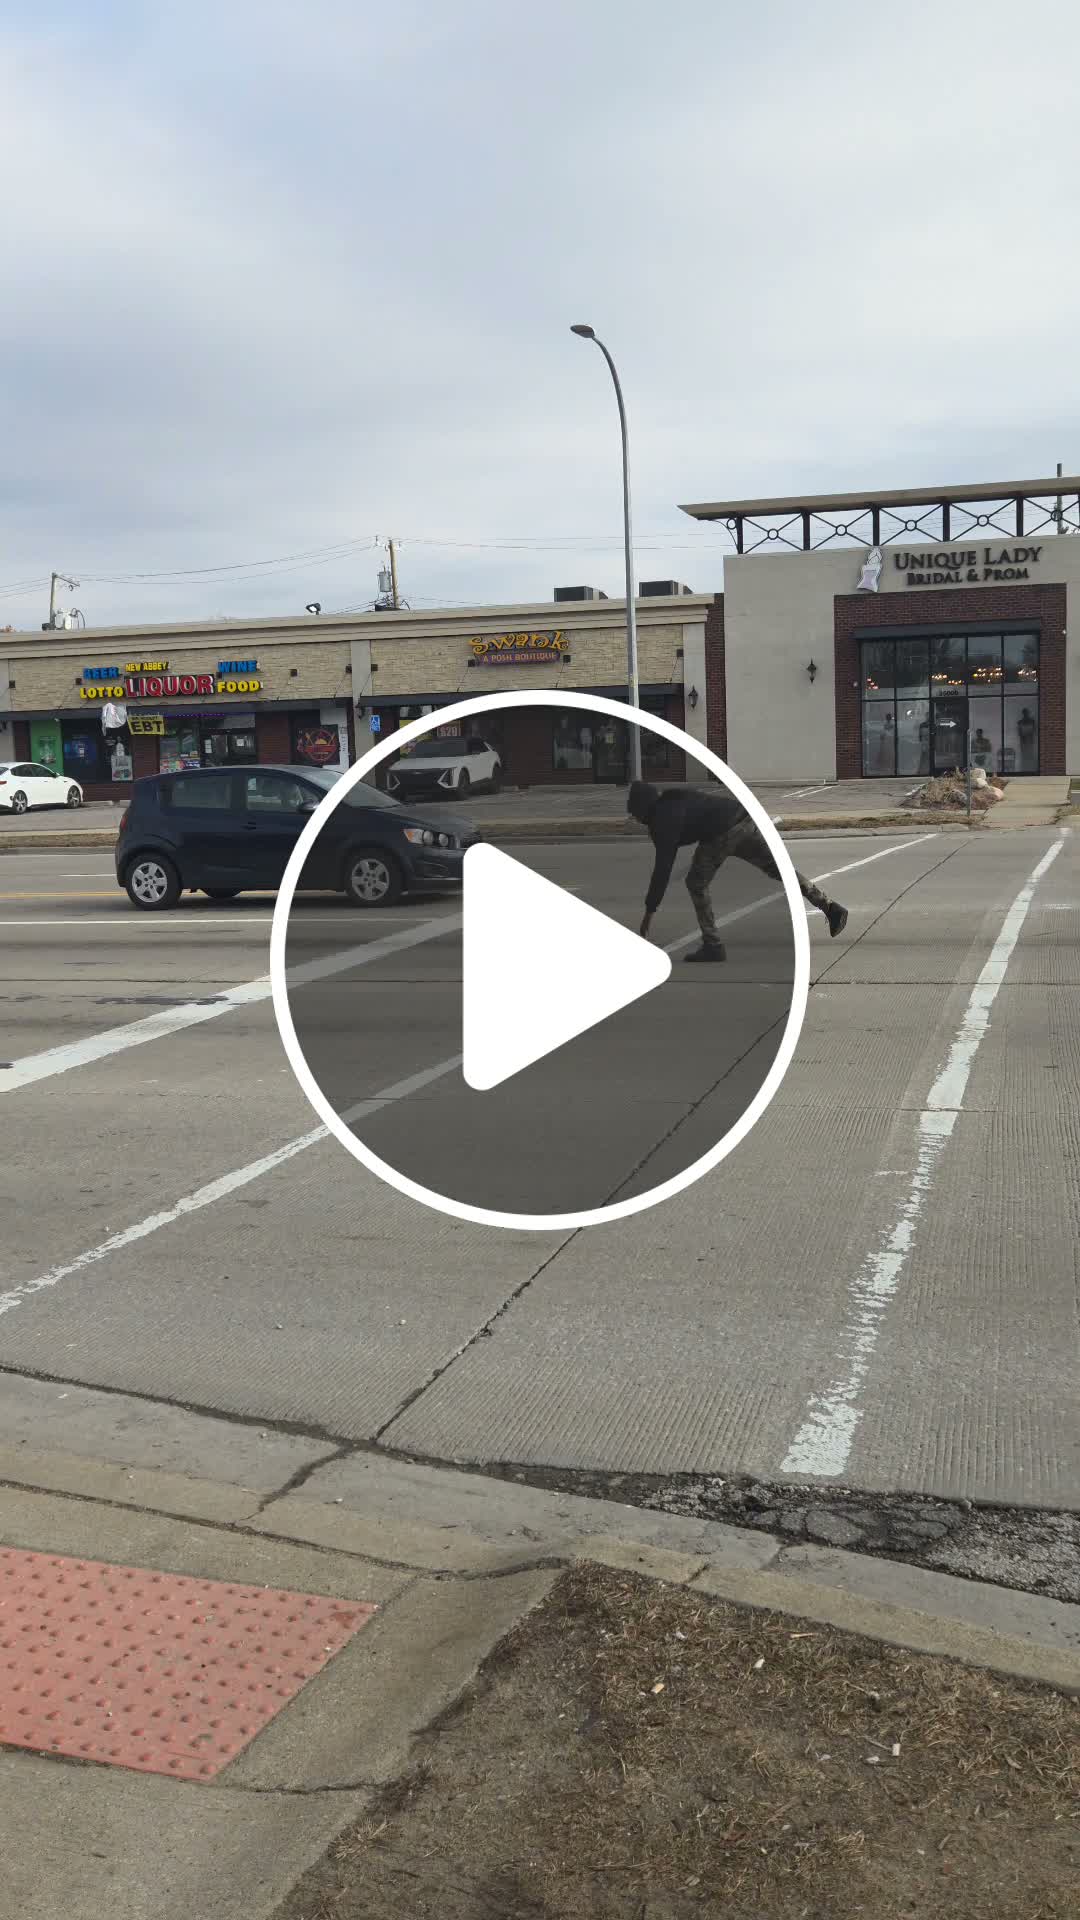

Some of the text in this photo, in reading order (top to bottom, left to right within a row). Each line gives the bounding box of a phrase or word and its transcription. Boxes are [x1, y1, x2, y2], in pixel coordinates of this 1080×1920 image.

[894, 546, 1043, 570] UNIQUE LADY
[906, 567, 1030, 586] BRIDAL & PROM
[469, 631, 569, 654] Swank
[491, 654, 512, 662] POSH
[515, 652, 557, 661] BOUTIQUE
[125, 661, 169, 672] NEW ABBEY
[217, 660, 259, 673] WINE
[83, 667, 120, 680] BEER
[79, 686, 124, 699] LOTTO
[125, 674, 214, 698] LIQUOR
[217, 680, 261, 693] FOOD
[130, 721, 162, 733] EBT
